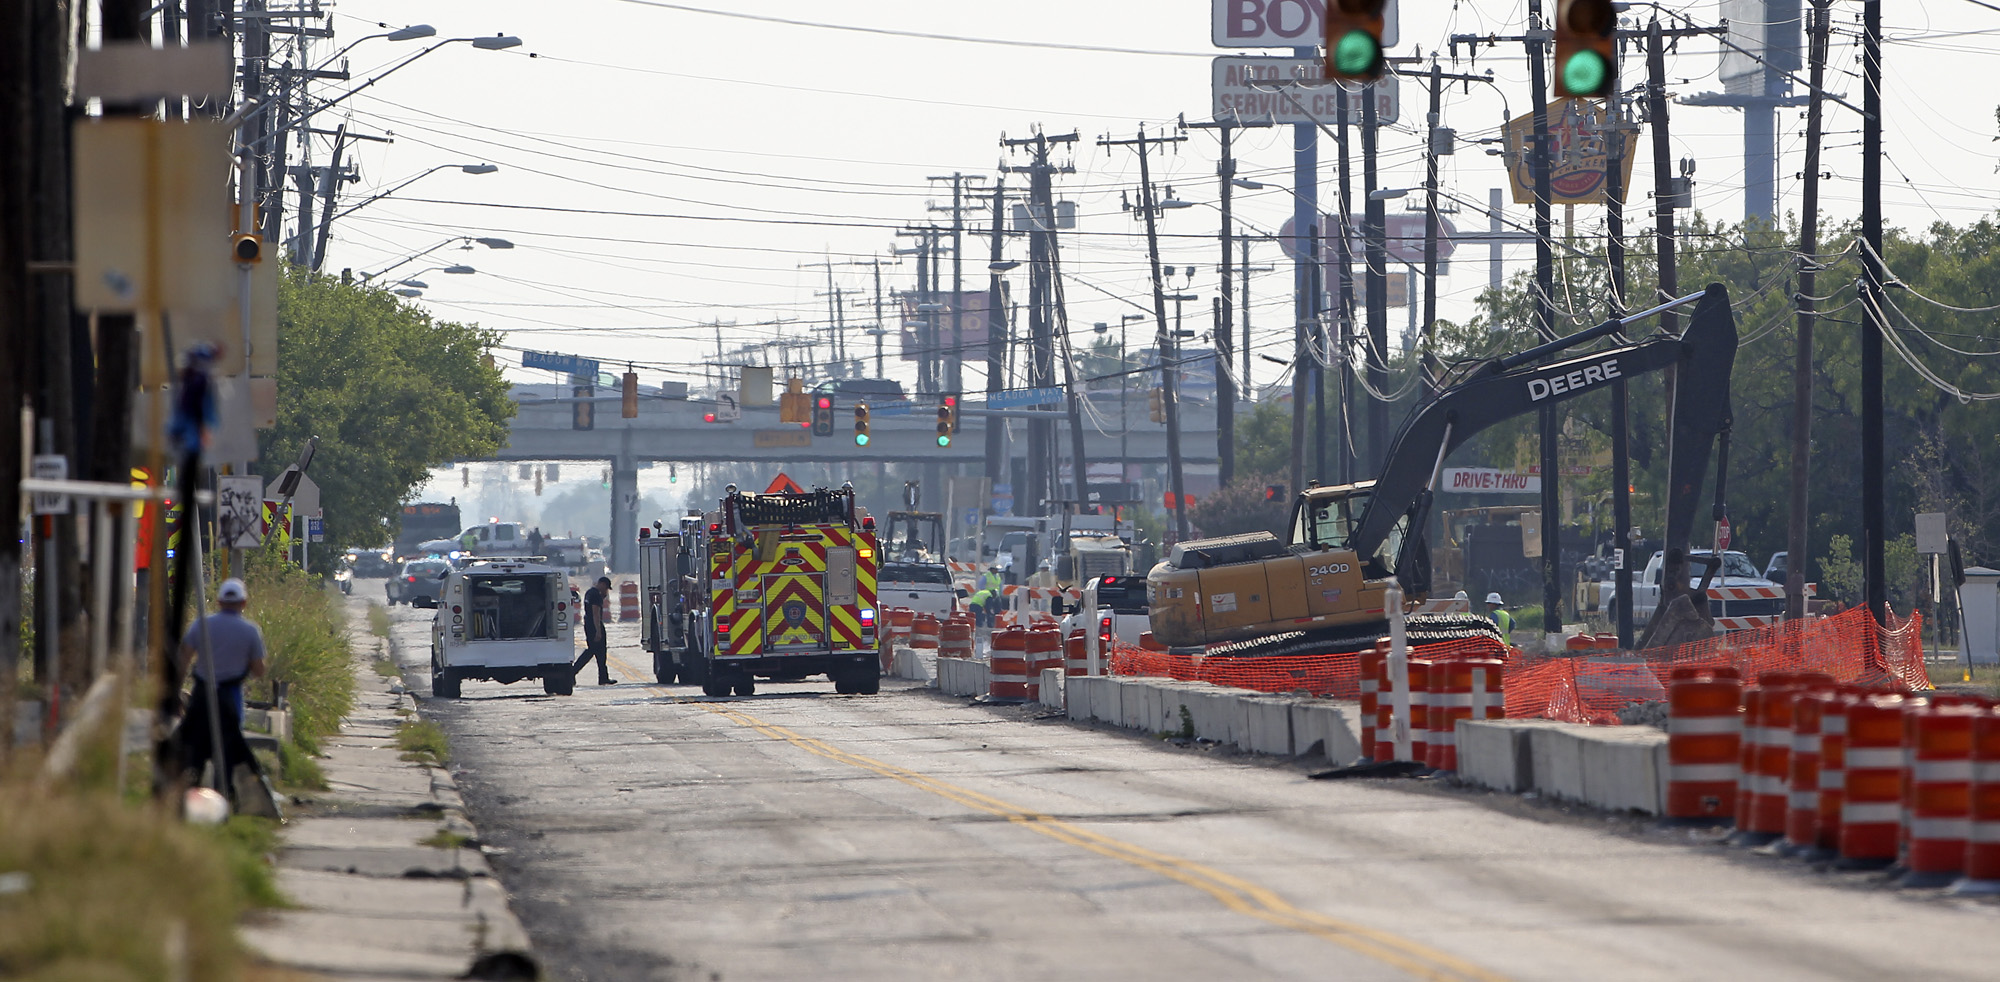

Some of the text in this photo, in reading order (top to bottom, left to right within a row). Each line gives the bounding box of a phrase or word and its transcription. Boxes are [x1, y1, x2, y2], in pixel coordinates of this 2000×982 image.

[1227, 0, 1328, 38] BOY
[1225, 65, 1280, 86] AUTO
[1220, 93, 1392, 116] SERVICE CETR
[524, 352, 597, 369] MEADOW WAY
[1527, 359, 1622, 402] DEERE
[989, 391, 1033, 401] MEADOW
[1040, 388, 1059, 397] WAY
[1453, 471, 1529, 489] DRIVE-THRU
[1719, 526, 1730, 539] STOP
[711, 541, 731, 553] E-34
[1309, 563, 1350, 577] 240D
[1311, 578, 1322, 586] LC
